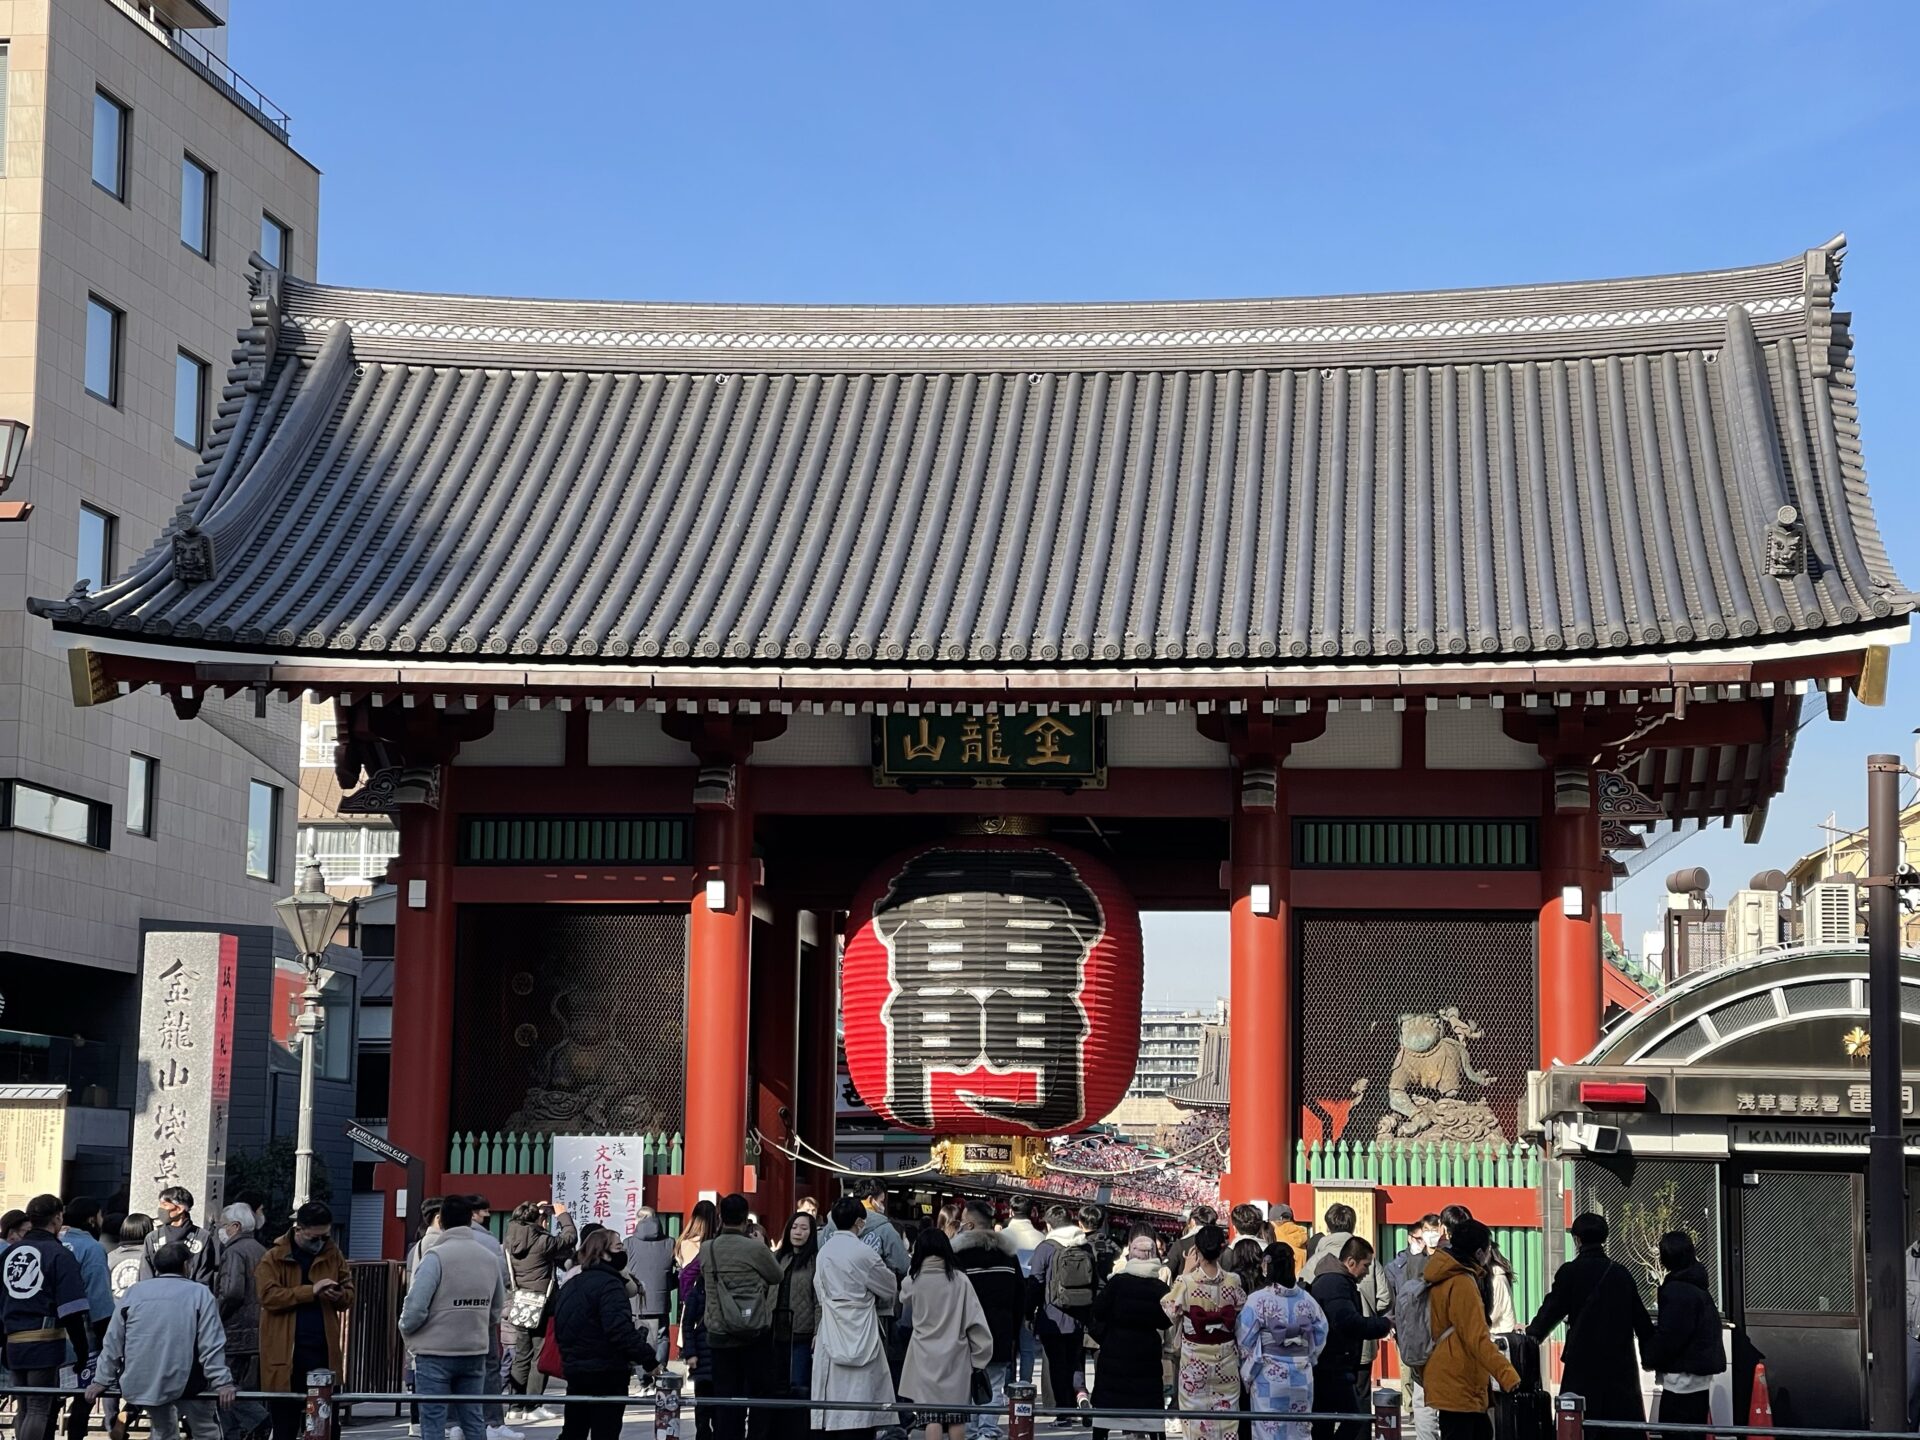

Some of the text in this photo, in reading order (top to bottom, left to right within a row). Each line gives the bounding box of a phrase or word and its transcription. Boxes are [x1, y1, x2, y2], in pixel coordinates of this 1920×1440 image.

[1736, 1093, 1841, 1113] 浅草警察署
[351, 1127, 393, 1153] KAMINARIMON
[392, 1149, 410, 1162] GATE
[966, 1147, 1009, 1160] 松下電器
[1749, 1130, 1871, 1146] KAMINARIMO
[612, 1142, 626, 1183] 浅草
[579, 1170, 590, 1231] 著名文化芸
[593, 1145, 613, 1224] 文化芸能
[624, 1180, 640, 1236] 二月三日
